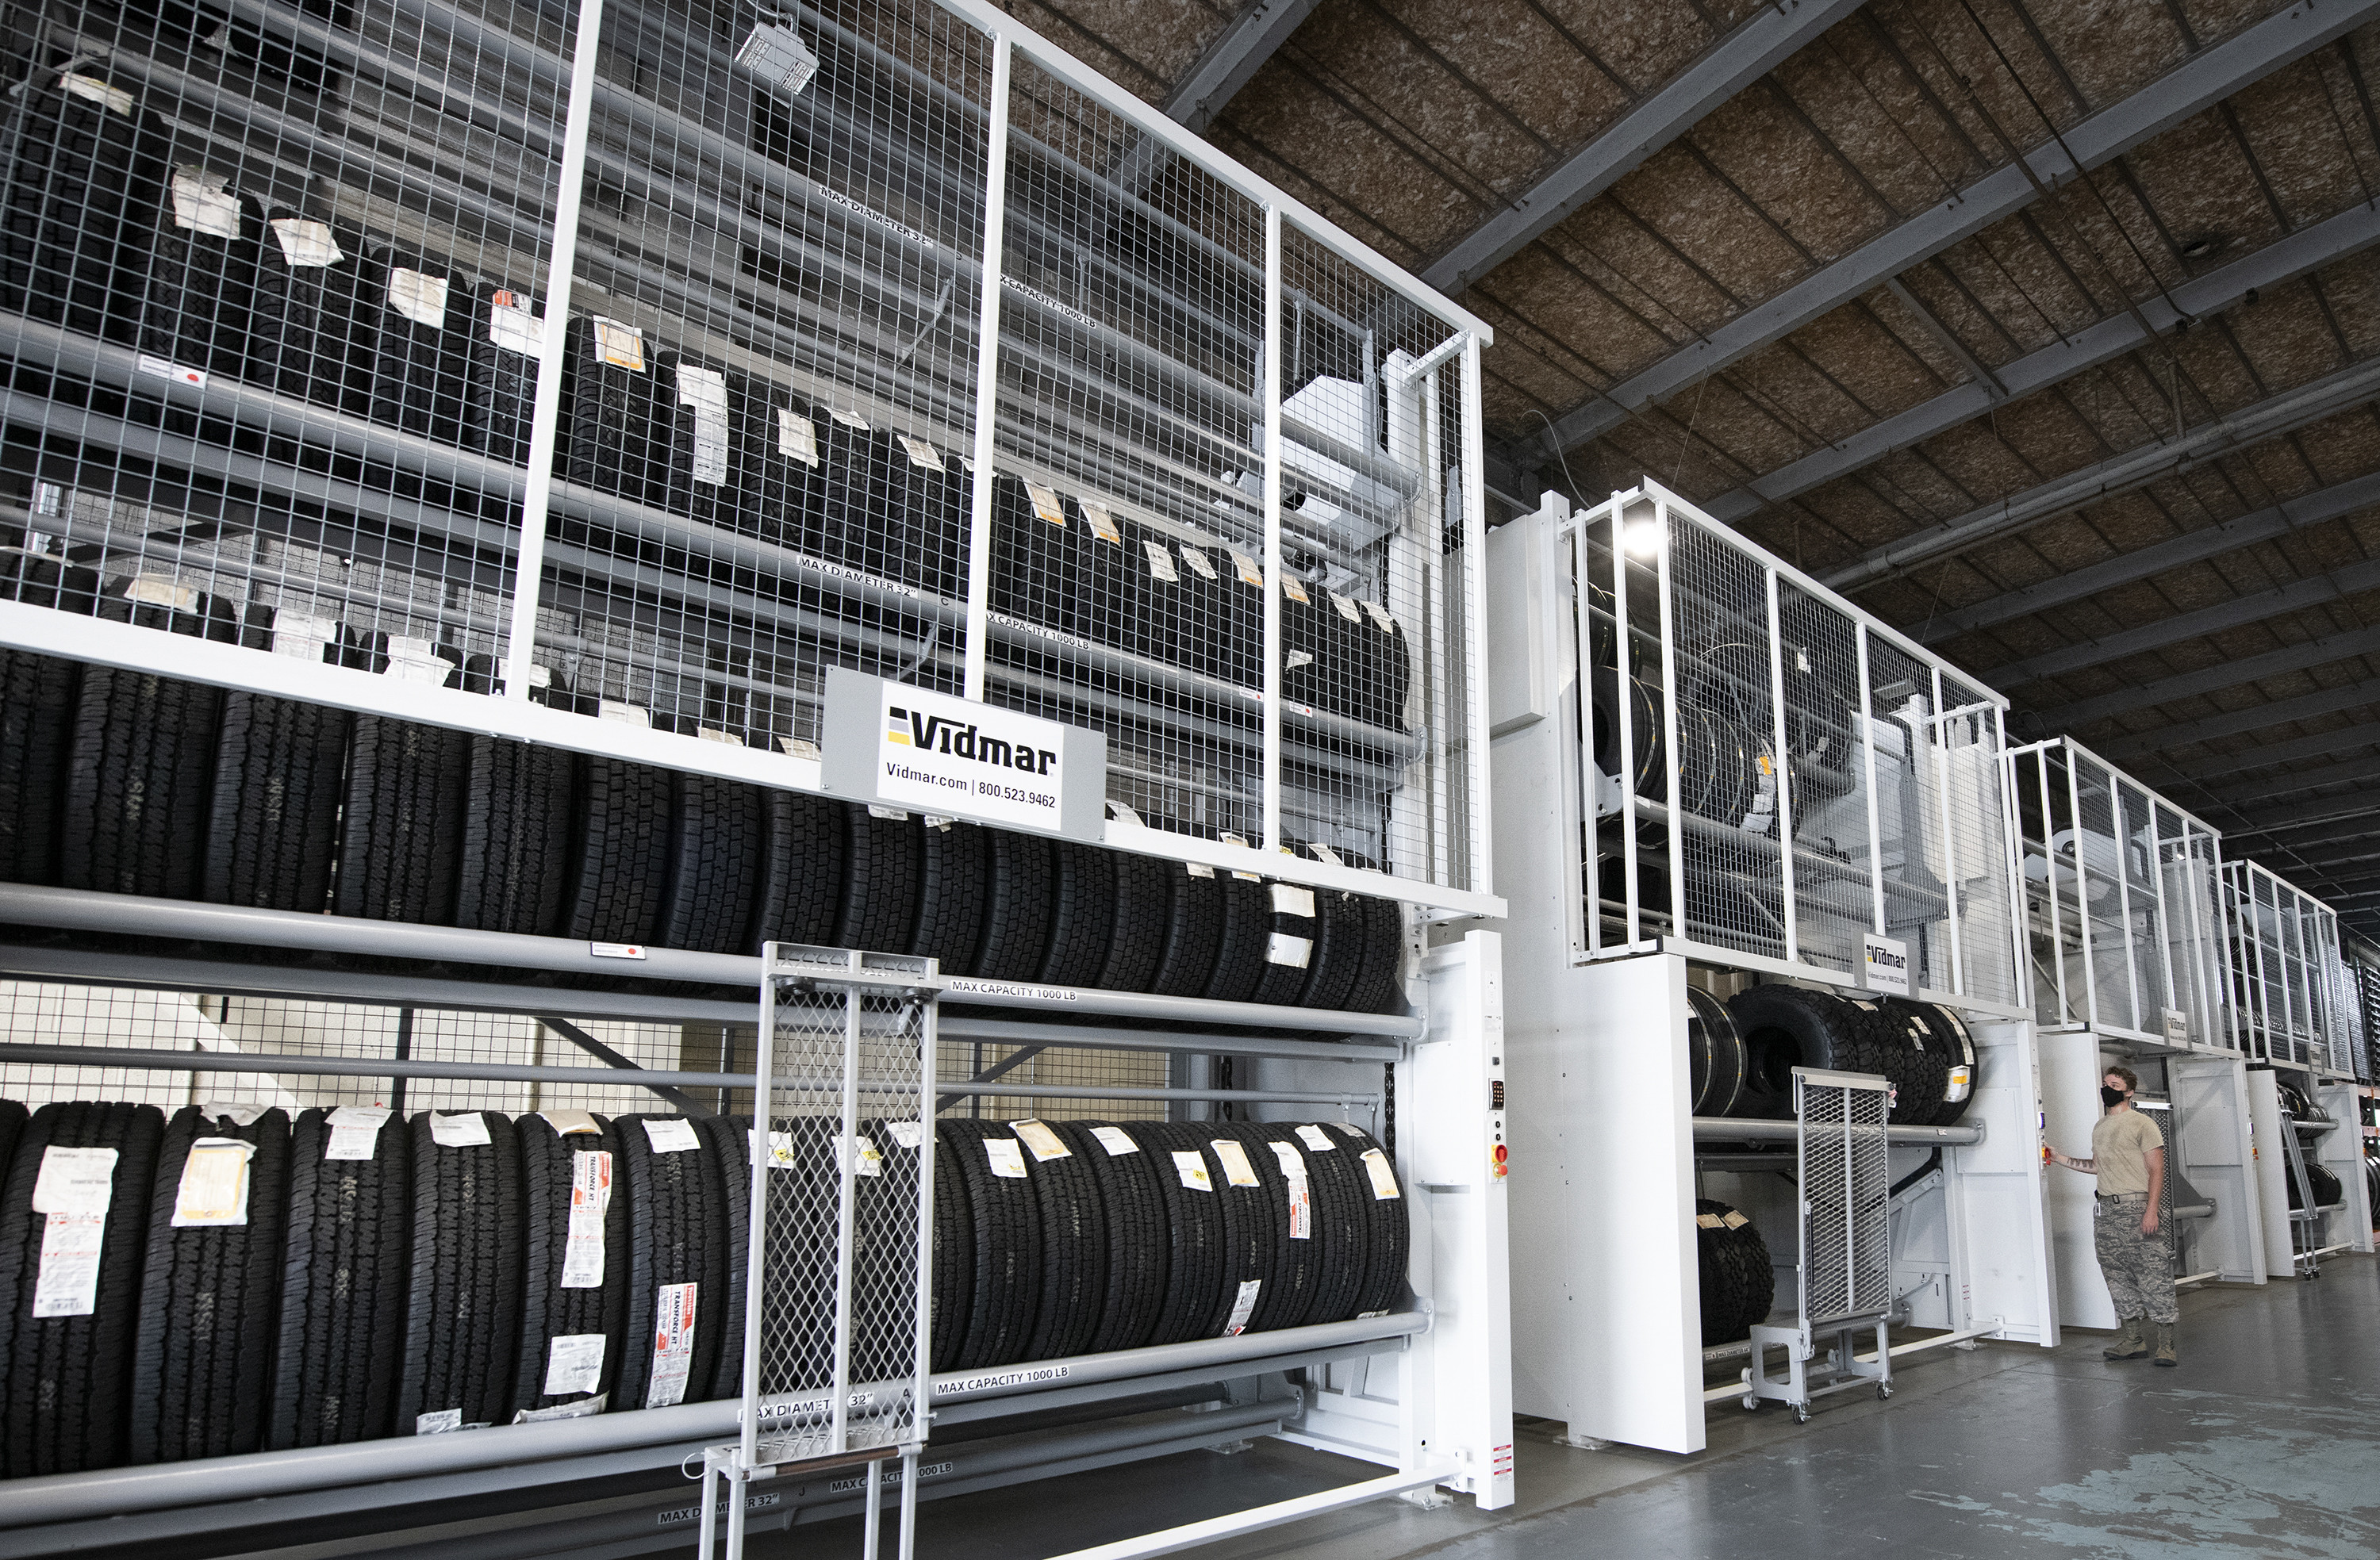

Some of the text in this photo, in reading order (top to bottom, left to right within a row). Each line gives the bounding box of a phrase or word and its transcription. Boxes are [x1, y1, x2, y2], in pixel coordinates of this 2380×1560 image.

[820, 187, 847, 206] MAX
[851, 203, 911, 237] DIAMETER
[1009, 279, 1057, 309] CAPACITY
[1059, 304, 1082, 321] 1000
[1084, 316, 1096, 328] LB
[800, 558, 827, 573] MAX
[831, 565, 894, 592] DIAMETER
[940, 597, 950, 607] C
[998, 615, 1049, 638] CAPACITY
[1051, 632, 1075, 646] 1000
[1077, 639, 1090, 650] LB
[911, 711, 1057, 776] Vidmar
[886, 761, 1056, 809] Vidmar.com 800.523.9462
[1871, 945, 1906, 970] Vidmar
[952, 981, 1077, 1001] MAX CAPACITY 1000 LB
[672, 1291, 681, 1335] TRANSFORCE
[938, 1366, 1069, 1394] MAX CAPACITY 1000 LB
[850, 1393, 873, 1406] 32"
[798, 1486, 806, 1497] J
[831, 1478, 857, 1491] MAX
[918, 1466, 938, 1478] 000
[939, 1463, 952, 1473] LB
[660, 1509, 689, 1524] MAX
[758, 1493, 779, 1506] 32"
